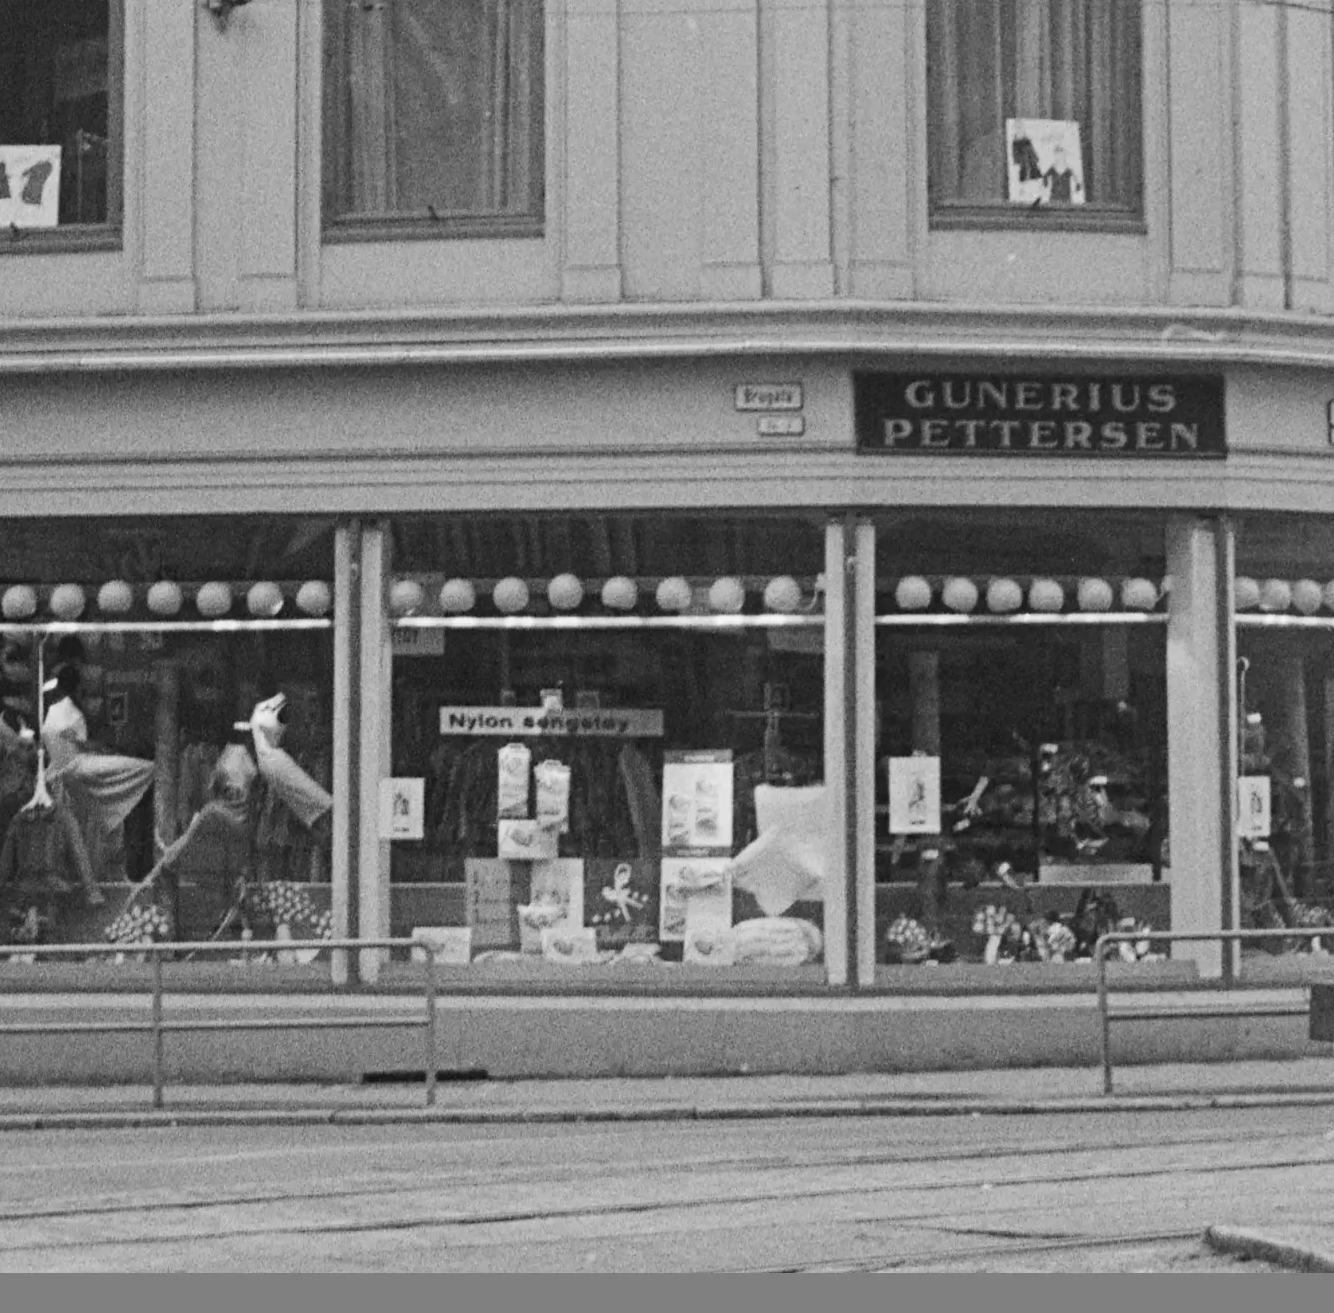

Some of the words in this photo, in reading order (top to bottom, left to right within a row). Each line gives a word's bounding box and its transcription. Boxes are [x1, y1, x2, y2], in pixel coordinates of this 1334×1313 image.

[903, 380, 1178, 413] GUNERIUS
[883, 418, 1200, 450] PETTERSEN
[449, 713, 513, 732] Nylon
